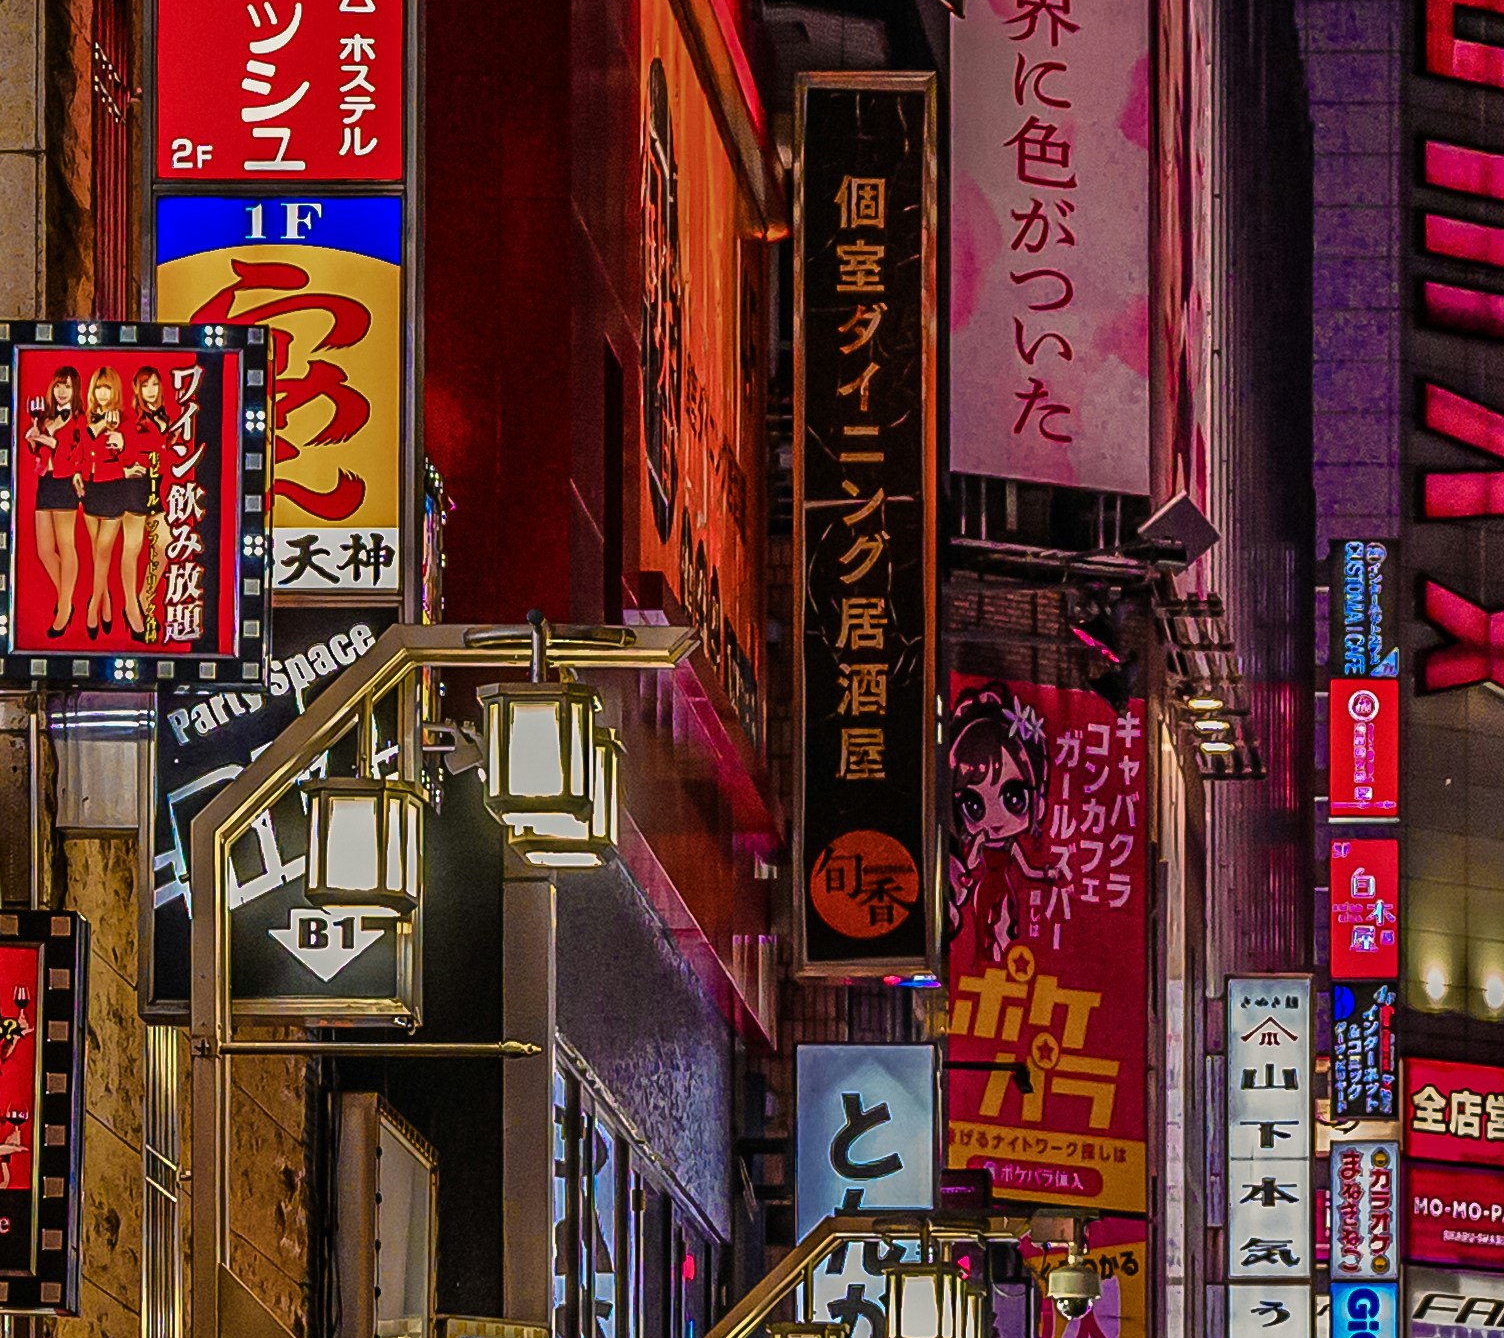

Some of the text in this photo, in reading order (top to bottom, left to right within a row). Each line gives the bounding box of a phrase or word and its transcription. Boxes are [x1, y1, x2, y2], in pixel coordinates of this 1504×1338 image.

[171, 138, 214, 169] 2F
[339, 35, 378, 157] ホステル
[243, 200, 323, 240] 1F
[165, 364, 206, 644] ワイン飲み放題
[833, 173, 890, 781] 個室ダイニング居酒屋
[167, 623, 377, 745] Party Space
[1045, 730, 1084, 950] ガールズバー
[1079, 722, 1111, 903] コンカフェ
[1105, 712, 1142, 910] キャバクラ
[297, 915, 355, 951] B1
[1339, 1149, 1366, 1274] まねきねこ
[1369, 1168, 1393, 1257] カラオケ
